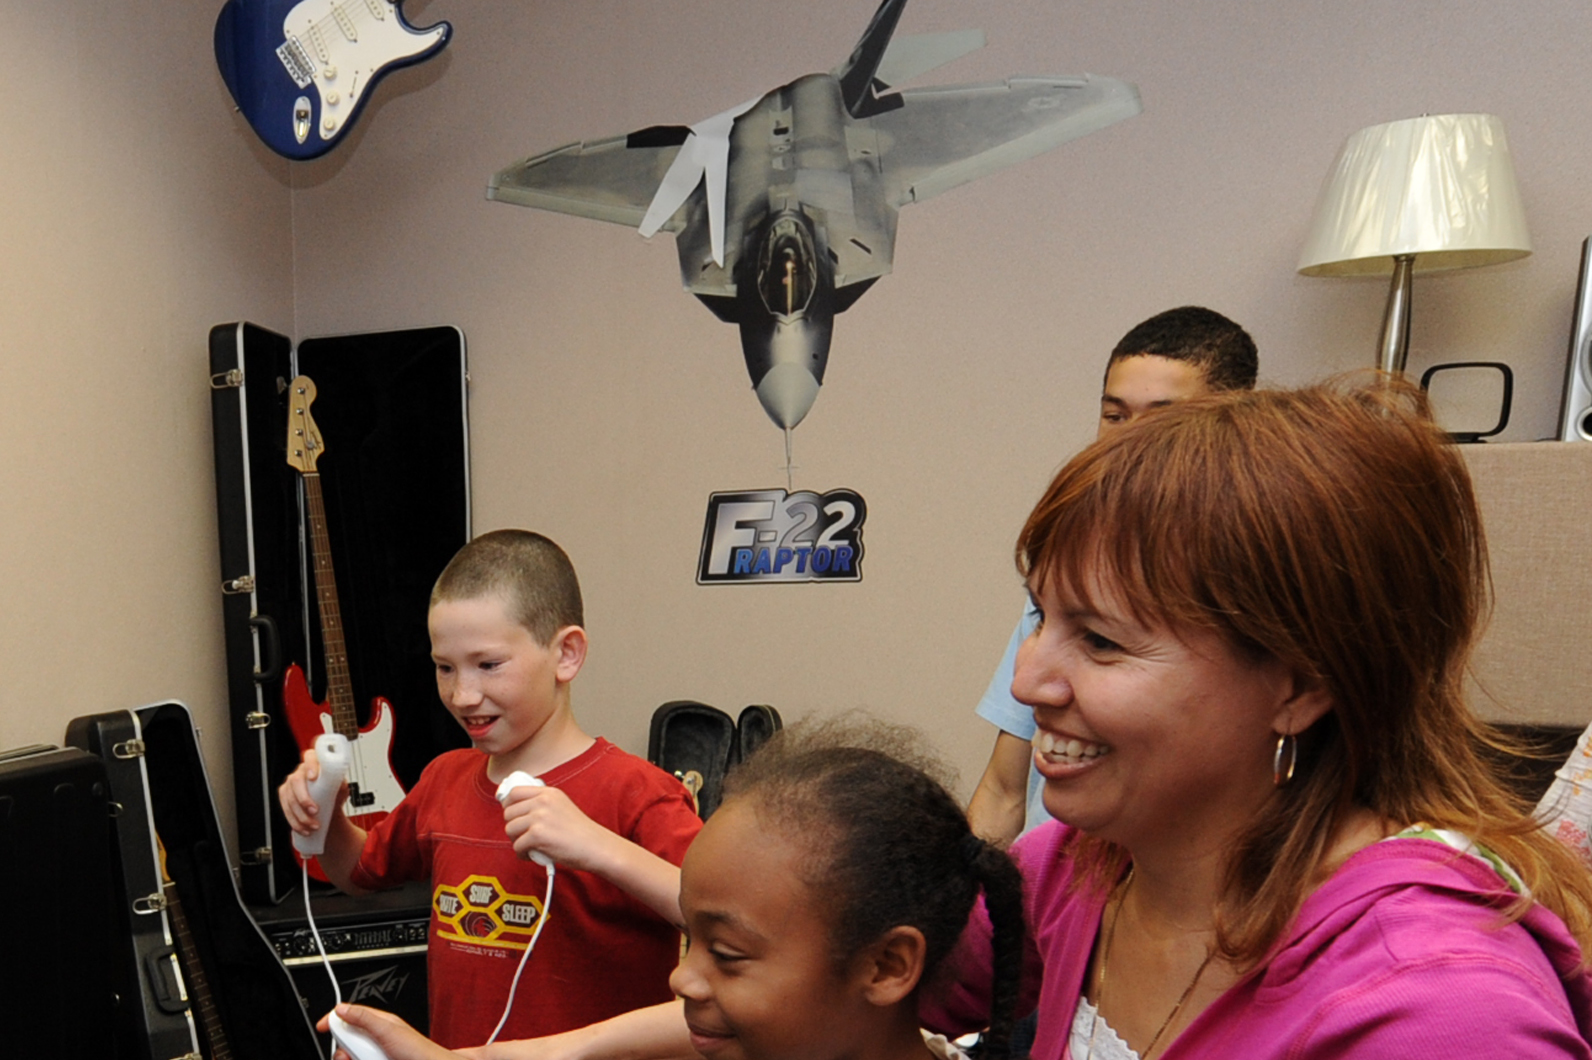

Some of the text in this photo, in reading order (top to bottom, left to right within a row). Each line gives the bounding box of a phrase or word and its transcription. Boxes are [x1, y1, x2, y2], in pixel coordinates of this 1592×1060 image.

[708, 500, 856, 575] F-22
[733, 545, 854, 575] RAPTOR
[469, 884, 494, 904] SURF
[502, 904, 537, 925] SLEEP
